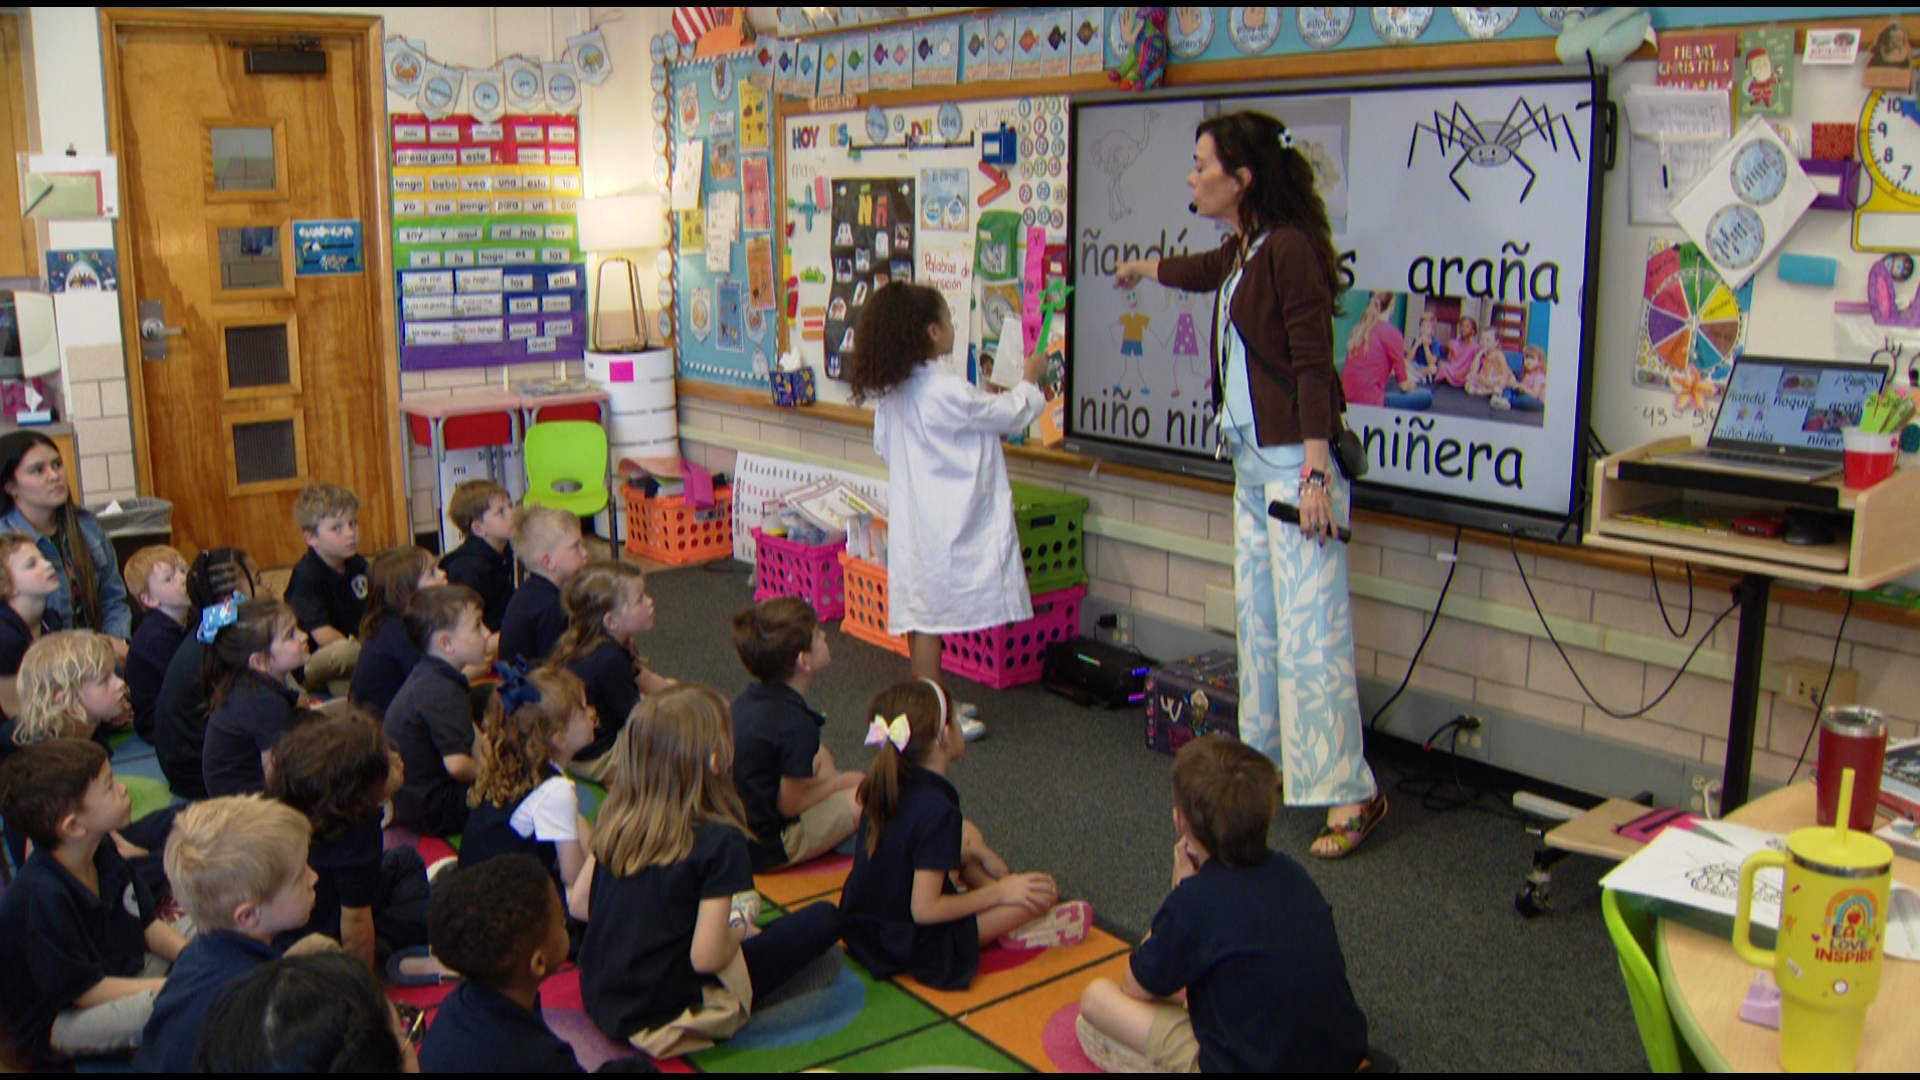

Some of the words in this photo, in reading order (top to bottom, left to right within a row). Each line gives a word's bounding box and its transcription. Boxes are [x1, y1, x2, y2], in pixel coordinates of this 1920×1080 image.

[1674, 44, 1718, 60] MERRY
[1658, 59, 1730, 76] CHRISTMAS
[1886, 97, 1902, 114] 10
[792, 124, 820, 150] HOY
[829, 122, 849, 148] ES
[1878, 121, 1888, 138] 9
[1883, 146, 1894, 164] 8
[1902, 164, 1912, 181] 7
[403, 203, 416, 212] yo
[435, 204, 450, 212] me
[532, 203, 544, 211] un
[420, 255, 430, 265] el
[454, 253, 464, 263] la
[515, 251, 526, 259] es
[1407, 240, 1560, 305] araña
[511, 278, 524, 288] los
[516, 301, 532, 310] son
[1080, 388, 1150, 439] niño
[1167, 400, 1220, 449] niñ
[1806, 431, 1844, 447] niñer
[1363, 416, 1524, 490] niñera
[1830, 938, 1868, 951] LOVE
[1815, 947, 1875, 963] INSPIRE
